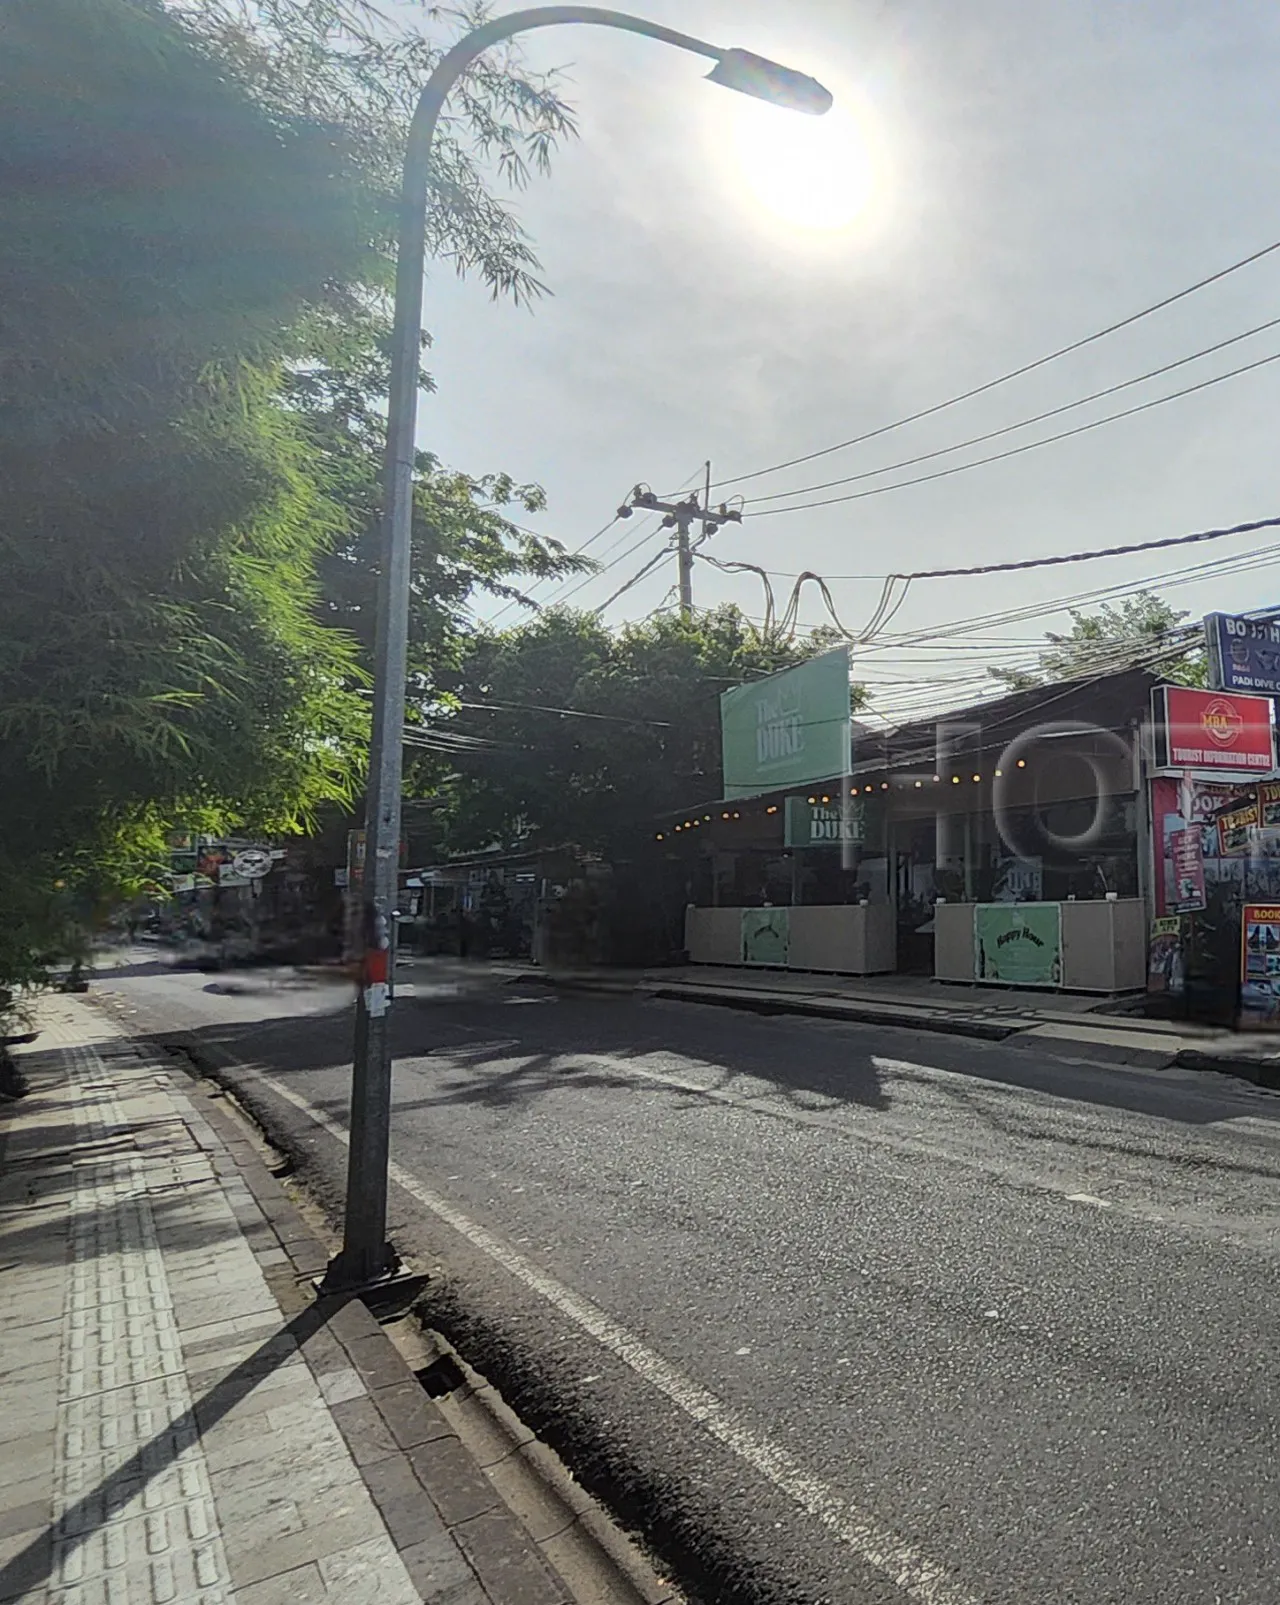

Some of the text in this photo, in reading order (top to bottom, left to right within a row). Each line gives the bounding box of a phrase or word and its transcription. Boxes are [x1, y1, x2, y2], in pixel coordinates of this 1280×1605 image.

[1232, 675, 1253, 687] PADI
[1254, 679, 1275, 690] DIVE
[756, 715, 805, 763] DUKE
[1172, 748, 1203, 762] TOURIST
[1203, 750, 1247, 764] INFORMATION
[811, 806, 839, 821] The
[810, 820, 865, 839] DUKE
